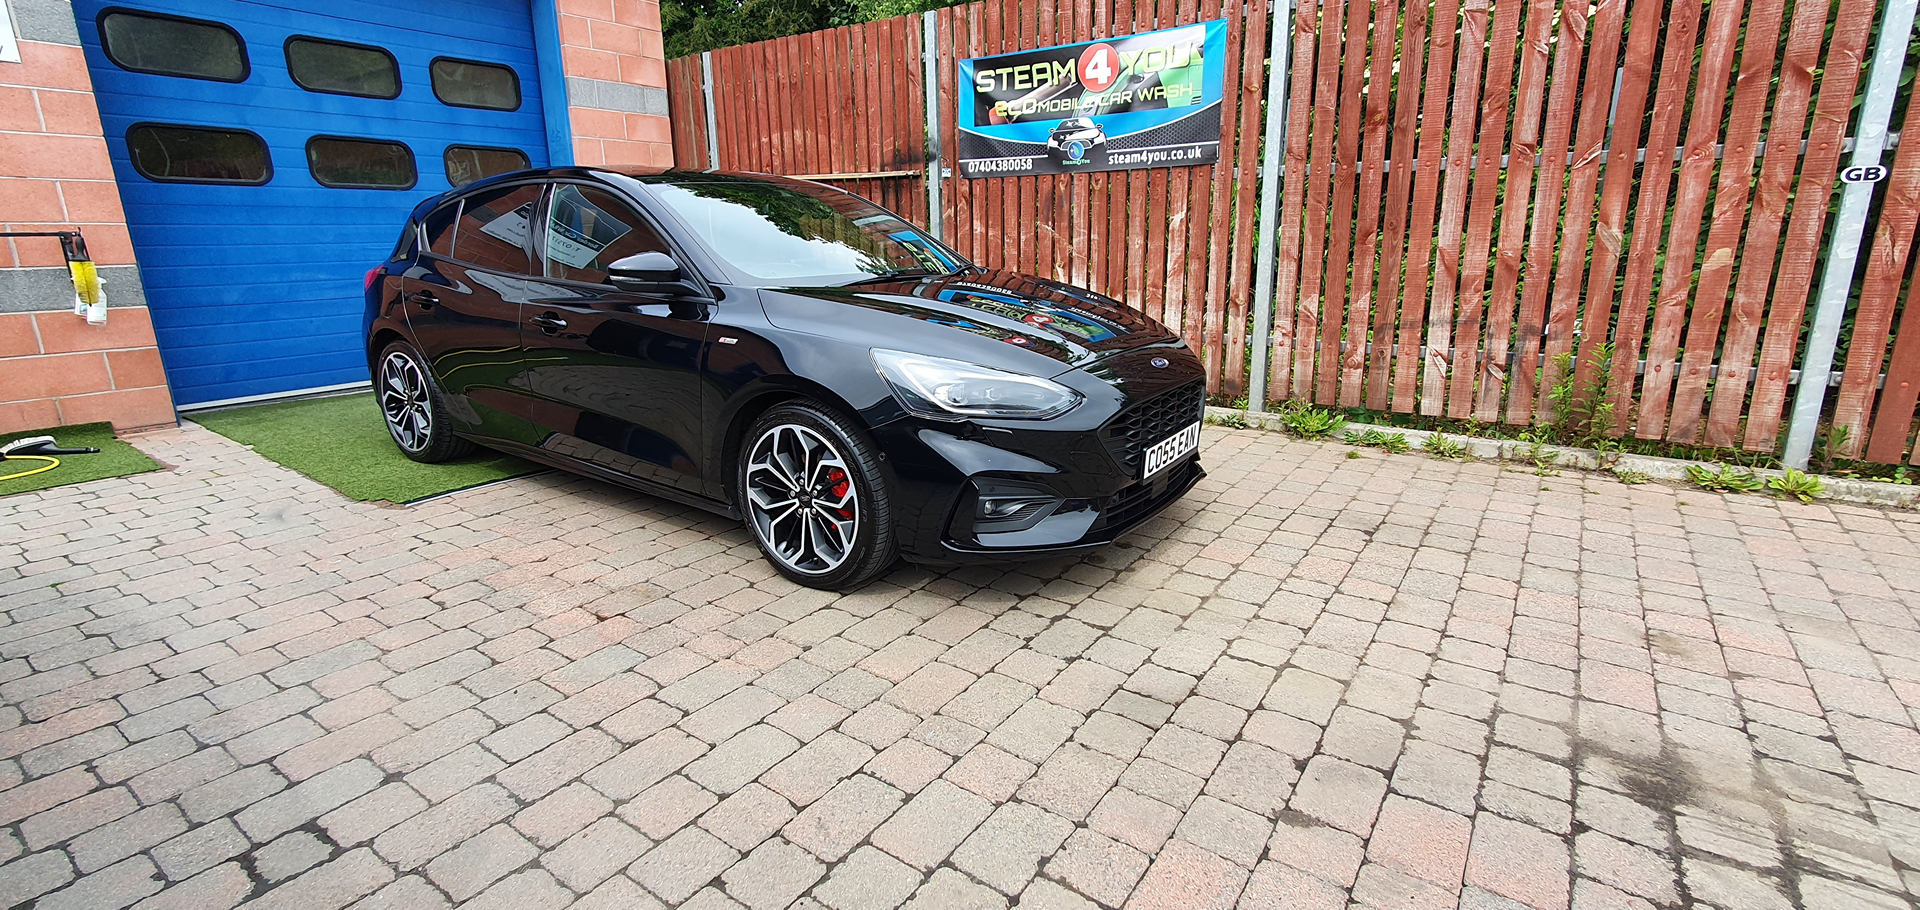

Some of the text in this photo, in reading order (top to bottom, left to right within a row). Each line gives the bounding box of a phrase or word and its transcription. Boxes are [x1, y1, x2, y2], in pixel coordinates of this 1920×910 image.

[976, 41, 1192, 93] STEAM 4 YOU
[1099, 90, 1132, 107] CAR
[1137, 83, 1193, 102] WASH
[968, 158, 1033, 173] 07404380058
[1108, 145, 1202, 165] steam4you.co.uk
[1845, 167, 1881, 181] GB
[1148, 424, 1197, 473] CO55 EAN
